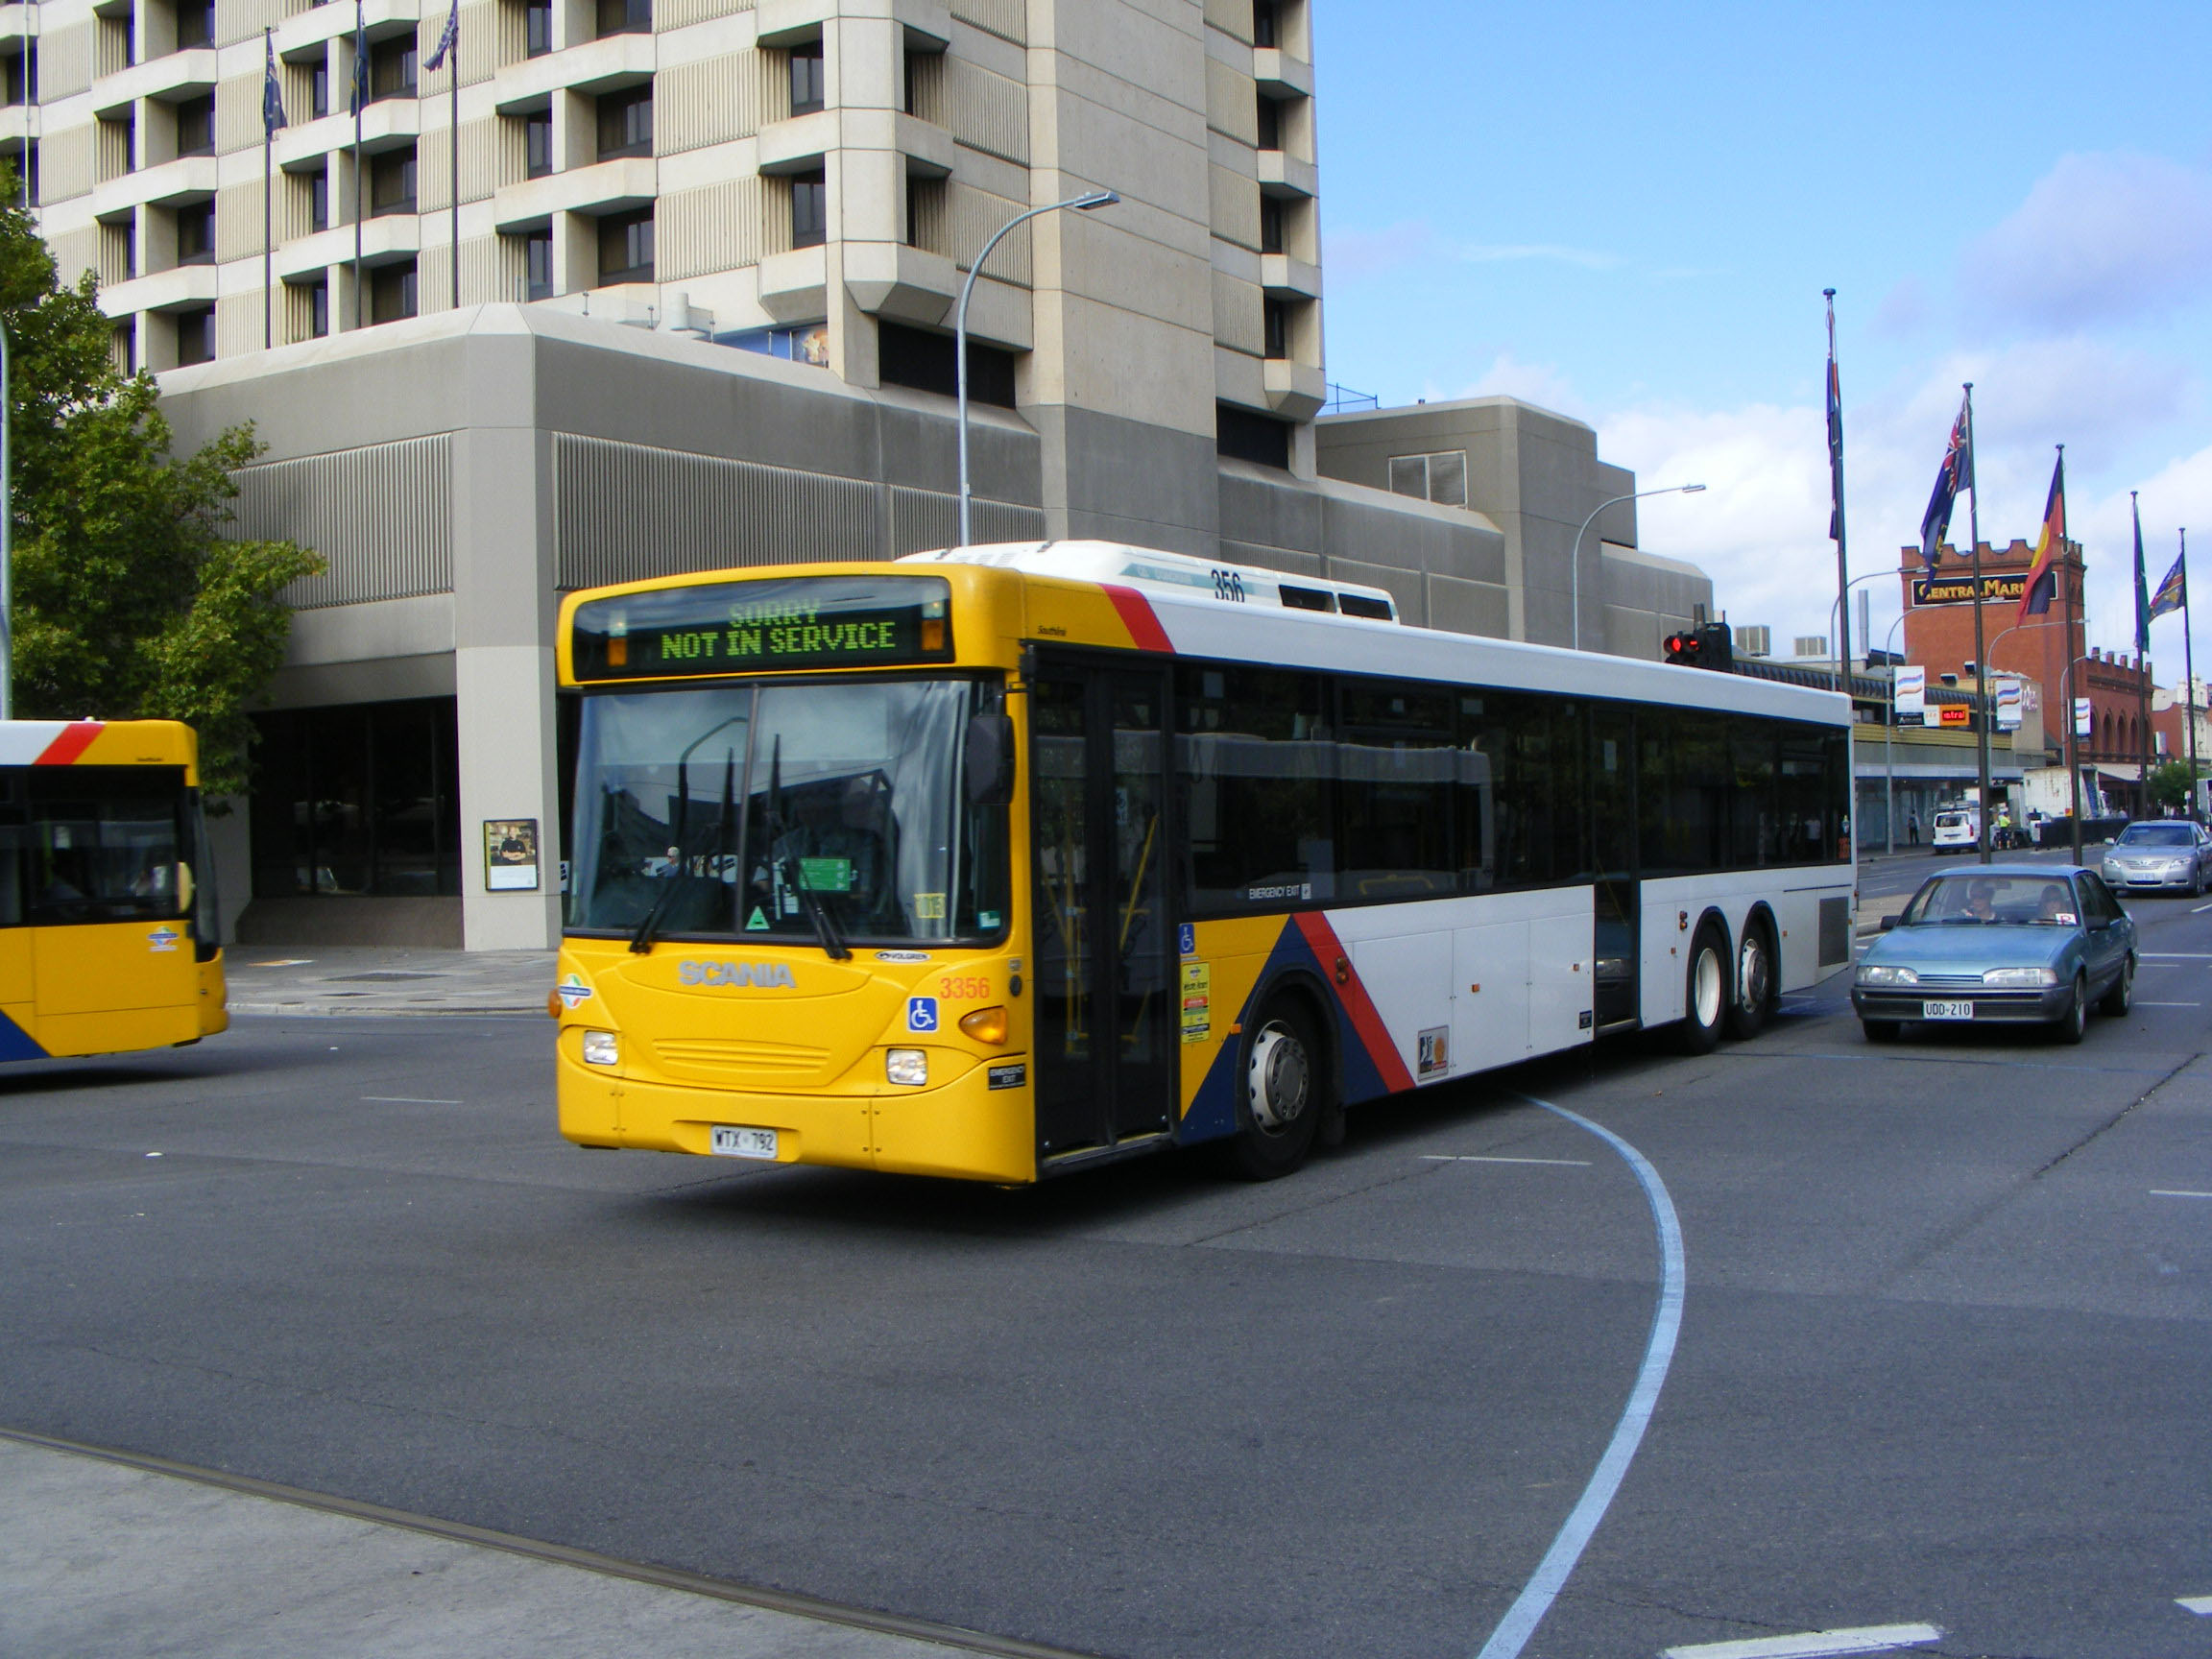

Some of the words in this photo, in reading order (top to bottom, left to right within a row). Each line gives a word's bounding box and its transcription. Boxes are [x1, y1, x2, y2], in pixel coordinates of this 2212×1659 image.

[1211, 568, 1244, 603] 356
[729, 598, 822, 628] SORRY
[661, 632, 719, 660] NOT
[726, 629, 761, 657] IN
[769, 621, 897, 654] SERVICE
[1249, 886, 1286, 900] EMERGENCY
[1286, 884, 1300, 897] EXIT
[678, 960, 798, 989] SCANIA
[940, 976, 991, 998] 3356
[1002, 1074, 1016, 1084] EXIT
[714, 1129, 741, 1148] WTX
[752, 1132, 775, 1151] 792
